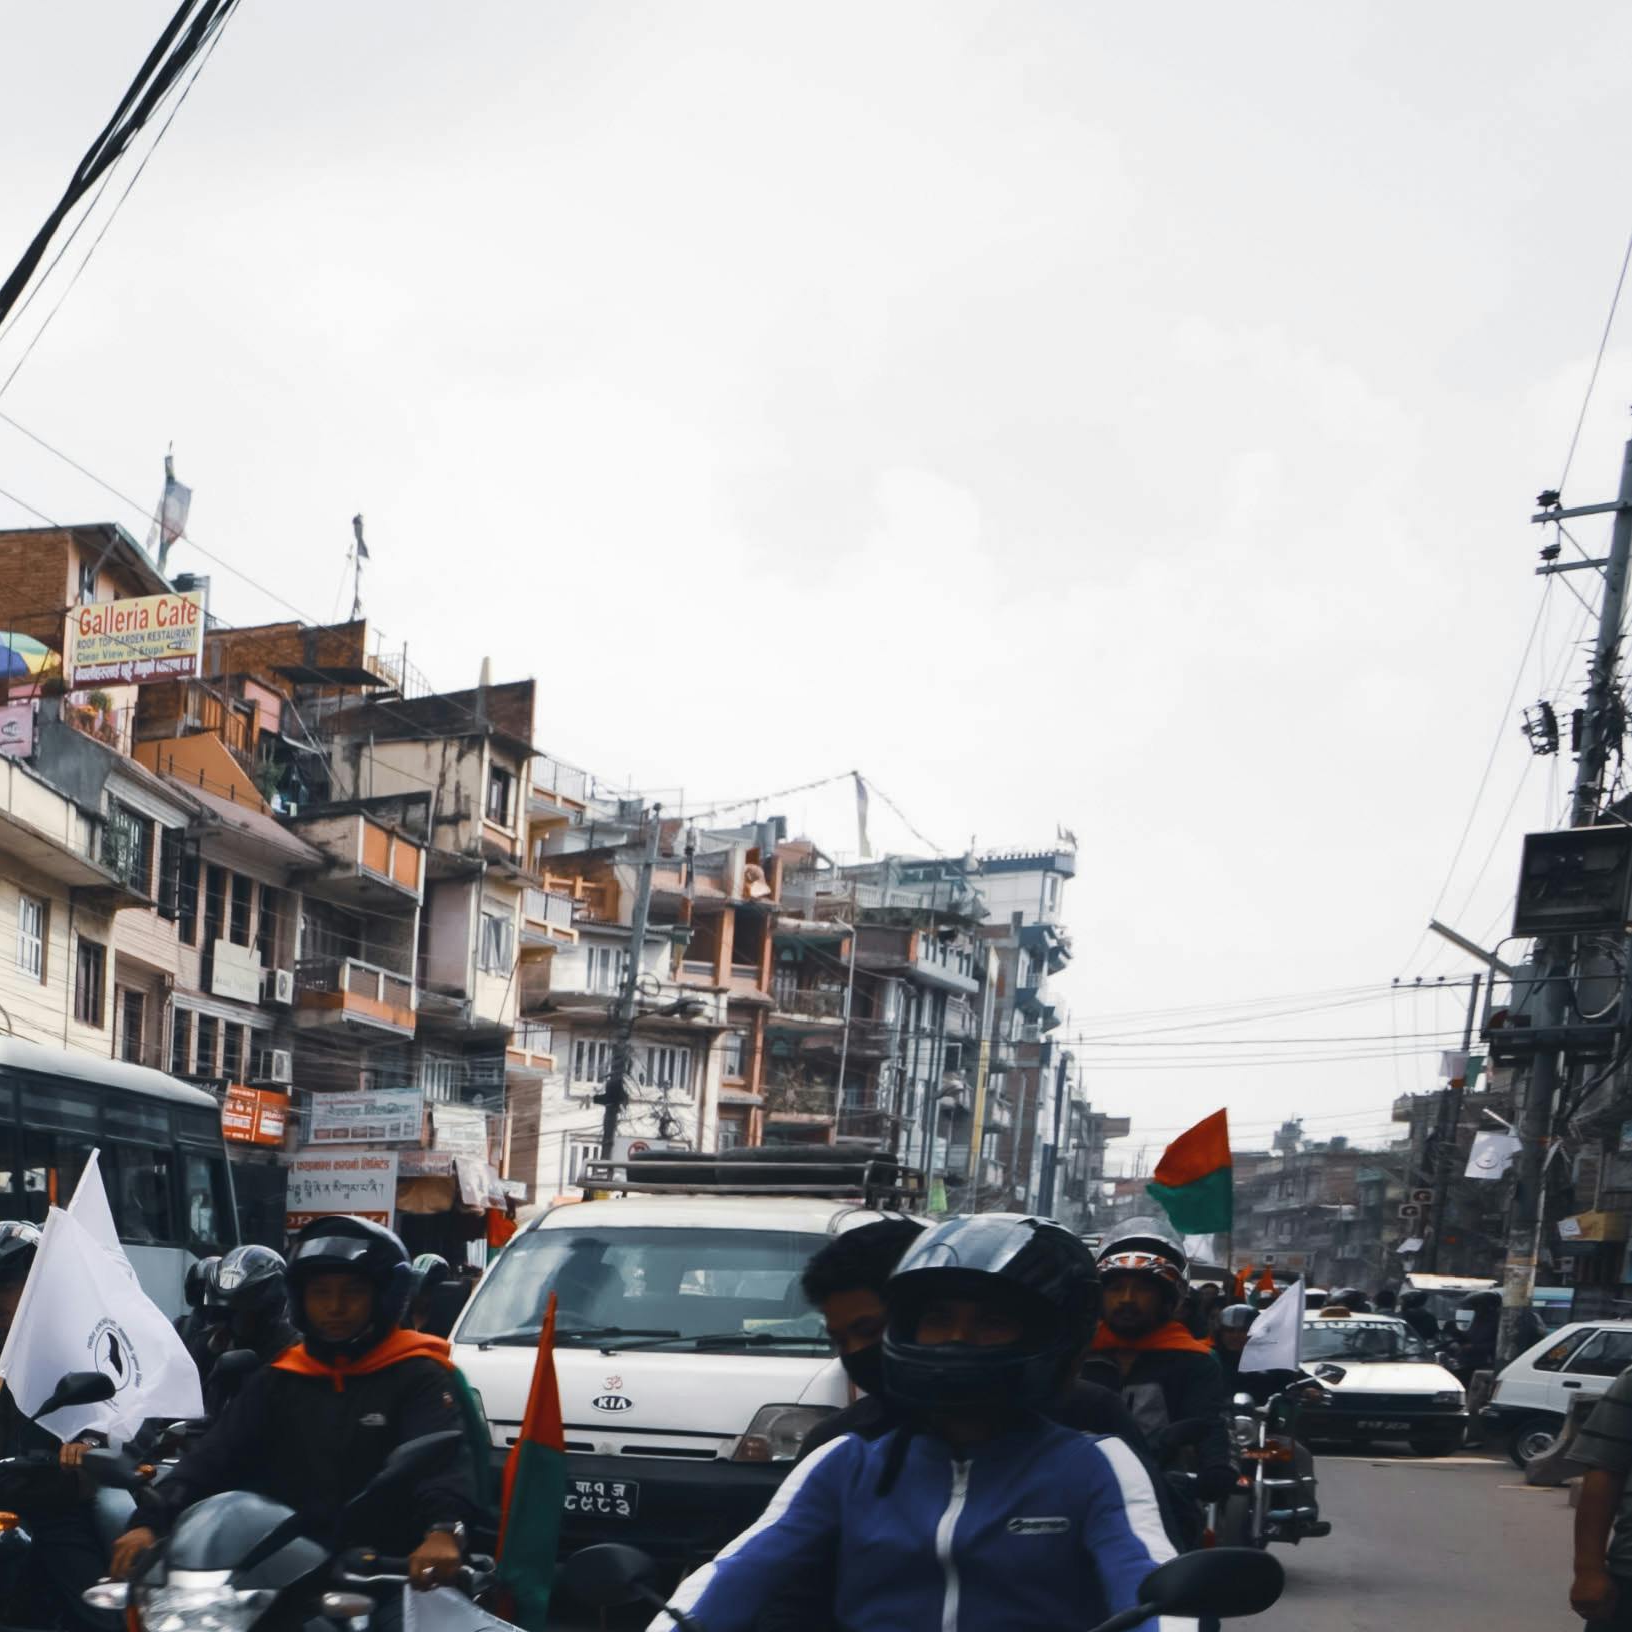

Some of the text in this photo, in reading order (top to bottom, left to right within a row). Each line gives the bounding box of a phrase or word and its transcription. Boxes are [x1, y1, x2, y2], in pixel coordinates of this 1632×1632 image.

[79, 597, 198, 636] Galleria Cafe
[147, 627, 196, 643] RESTAURANT
[598, 1397, 627, 1409] KIA
